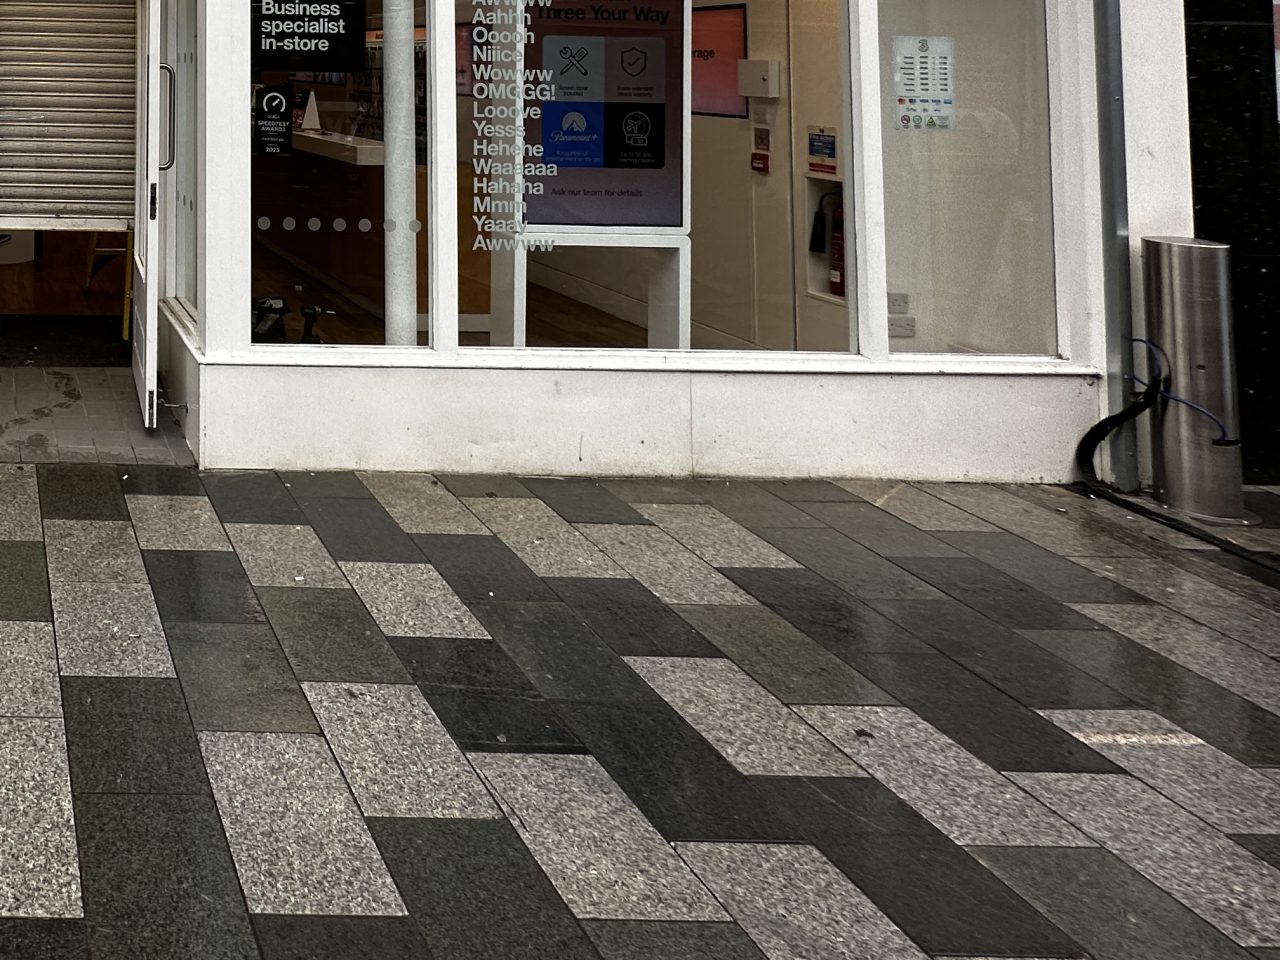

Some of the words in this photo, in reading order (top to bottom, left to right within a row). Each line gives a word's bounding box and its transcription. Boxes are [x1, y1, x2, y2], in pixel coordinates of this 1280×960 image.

[262, 0, 340, 16] Business
[472, 8, 531, 25] Aahhh
[534, 6, 586, 20] Three
[590, 5, 629, 21] Your
[633, 6, 670, 24] Way
[261, 18, 345, 35] specialist
[472, 26, 535, 44] Ooooh
[261, 35, 329, 51] in-store
[473, 45, 524, 62] Niiice
[472, 64, 553, 81] Wowww
[473, 83, 556, 100] OMGGG!
[473, 101, 541, 119] Looove
[472, 120, 526, 137] Yesss
[473, 139, 544, 156] Hehehe
[473, 177, 544, 195] Hahaha
[617, 189, 642, 197] details
[473, 196, 527, 213] Mmm
[472, 215, 528, 235] Yaaay
[472, 234, 555, 252] Awwww
